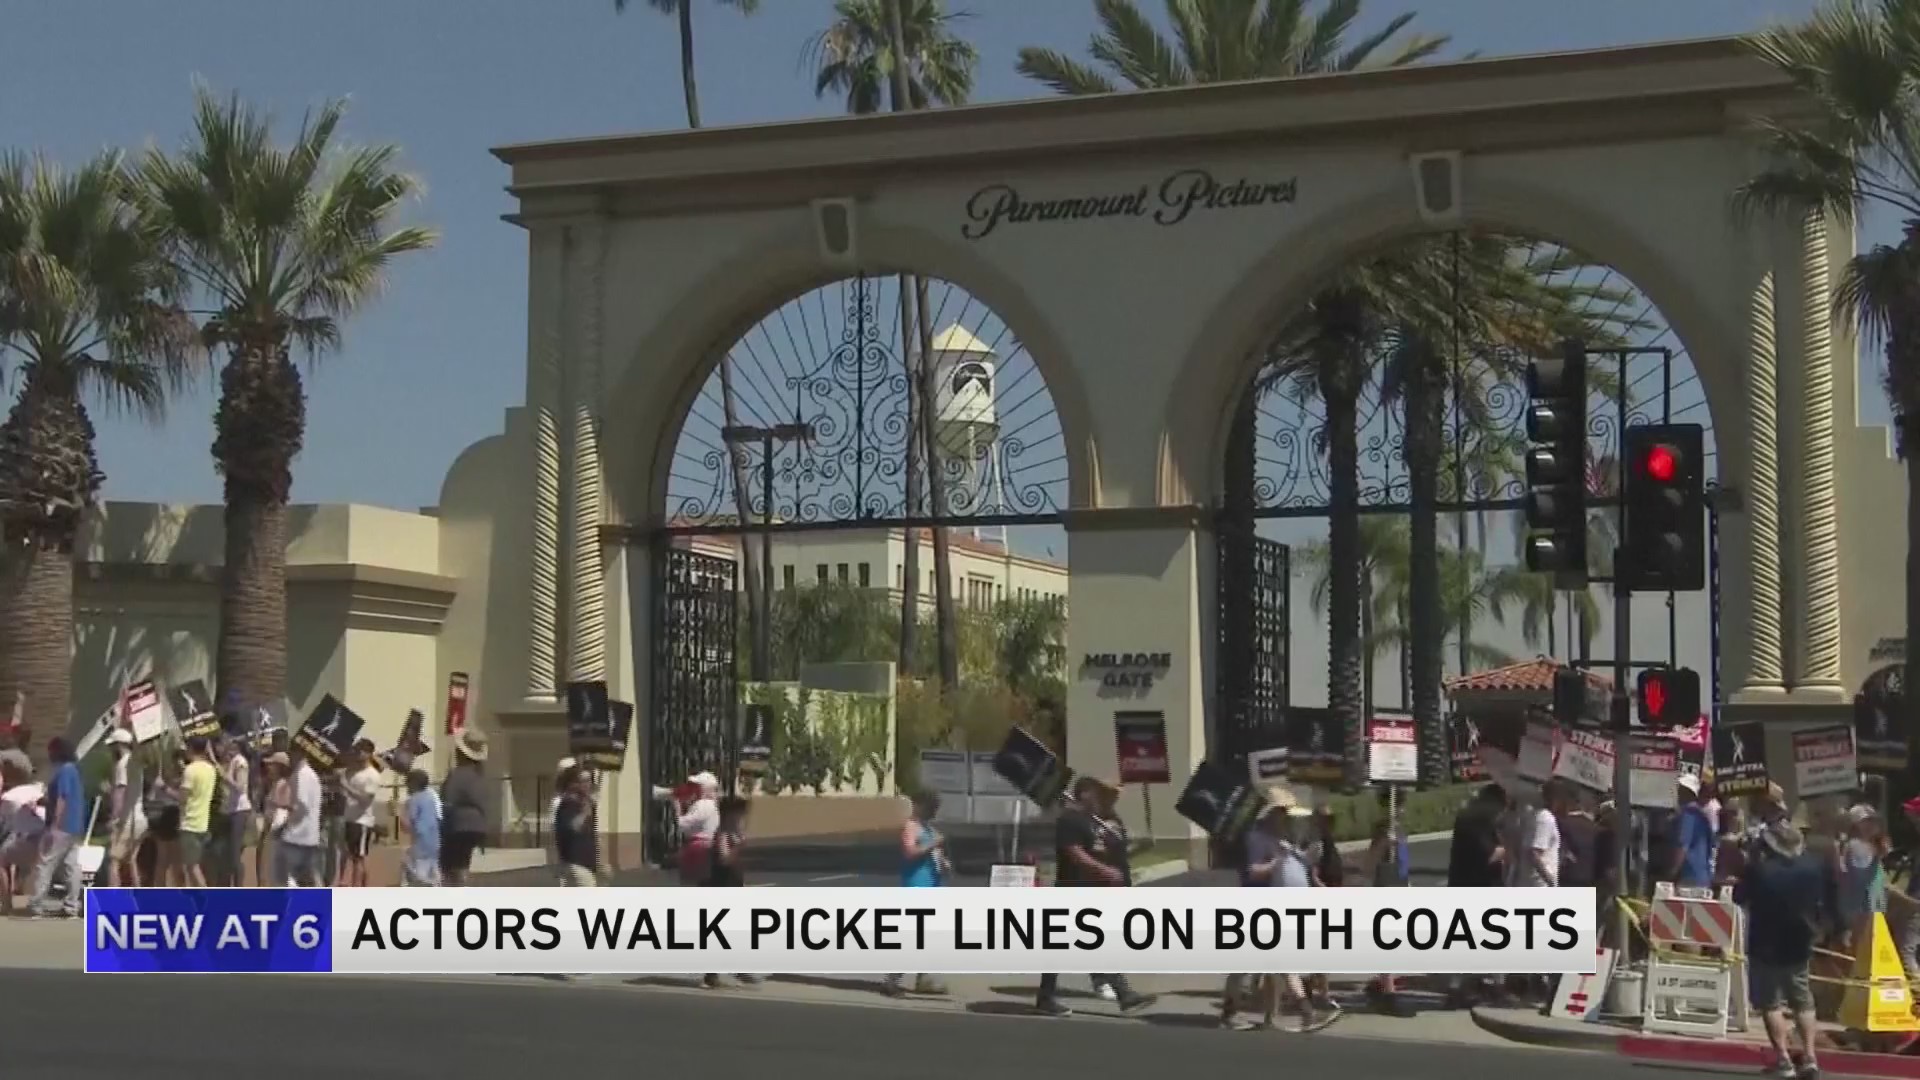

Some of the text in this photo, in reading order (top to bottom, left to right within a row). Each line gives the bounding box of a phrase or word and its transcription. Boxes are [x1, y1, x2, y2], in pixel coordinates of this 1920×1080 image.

[962, 169, 1297, 239] Paramount Pictures
[1085, 652, 1171, 668] MELROSE
[1103, 672, 1153, 688] GATE
